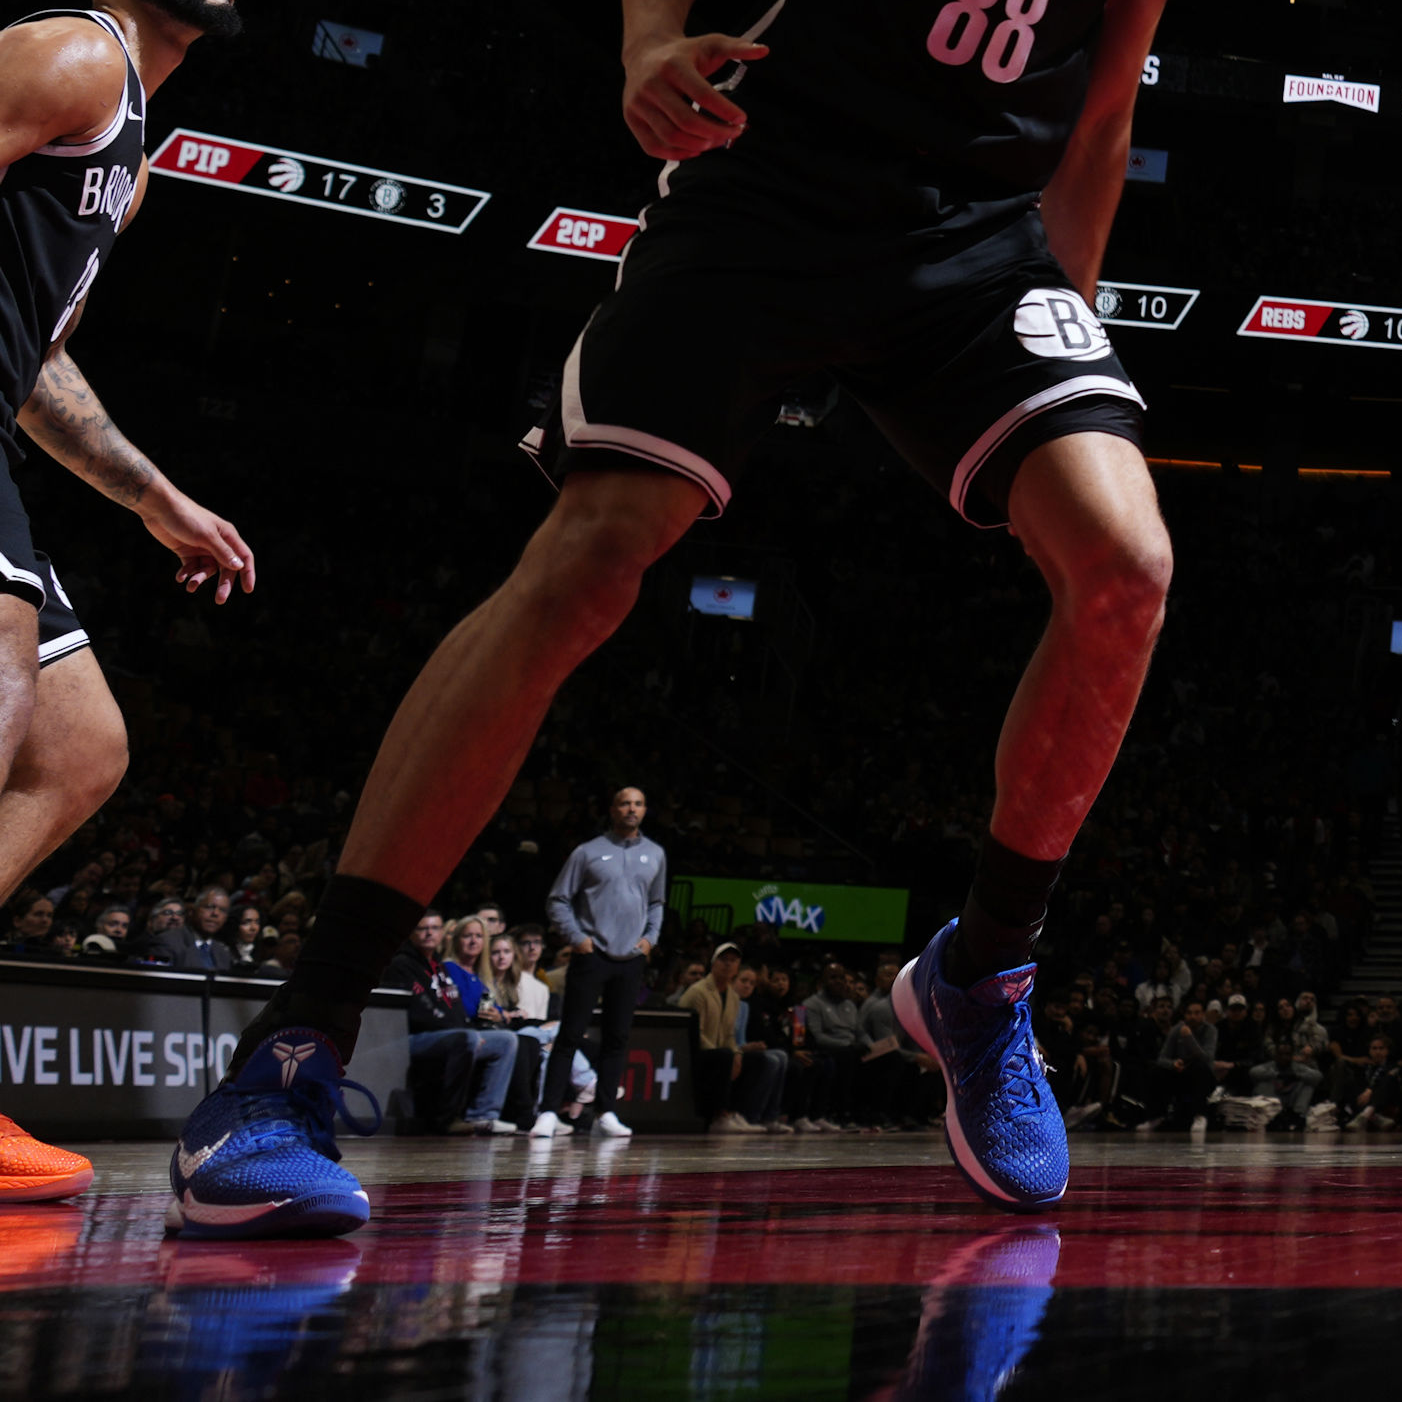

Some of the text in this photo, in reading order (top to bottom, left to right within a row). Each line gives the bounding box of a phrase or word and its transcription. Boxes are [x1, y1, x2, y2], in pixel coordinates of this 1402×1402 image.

[1288, 80, 1375, 106] FOUNDATION
[178, 139, 446, 218] PIP 17 3
[556, 218, 606, 247] 2CP
[1046, 298, 1091, 349] B
[1137, 295, 1167, 319] 10
[1261, 306, 1305, 330] REBS
[755, 896, 823, 934] MAX
[0, 1025, 240, 1087] VE LIVE SPO
